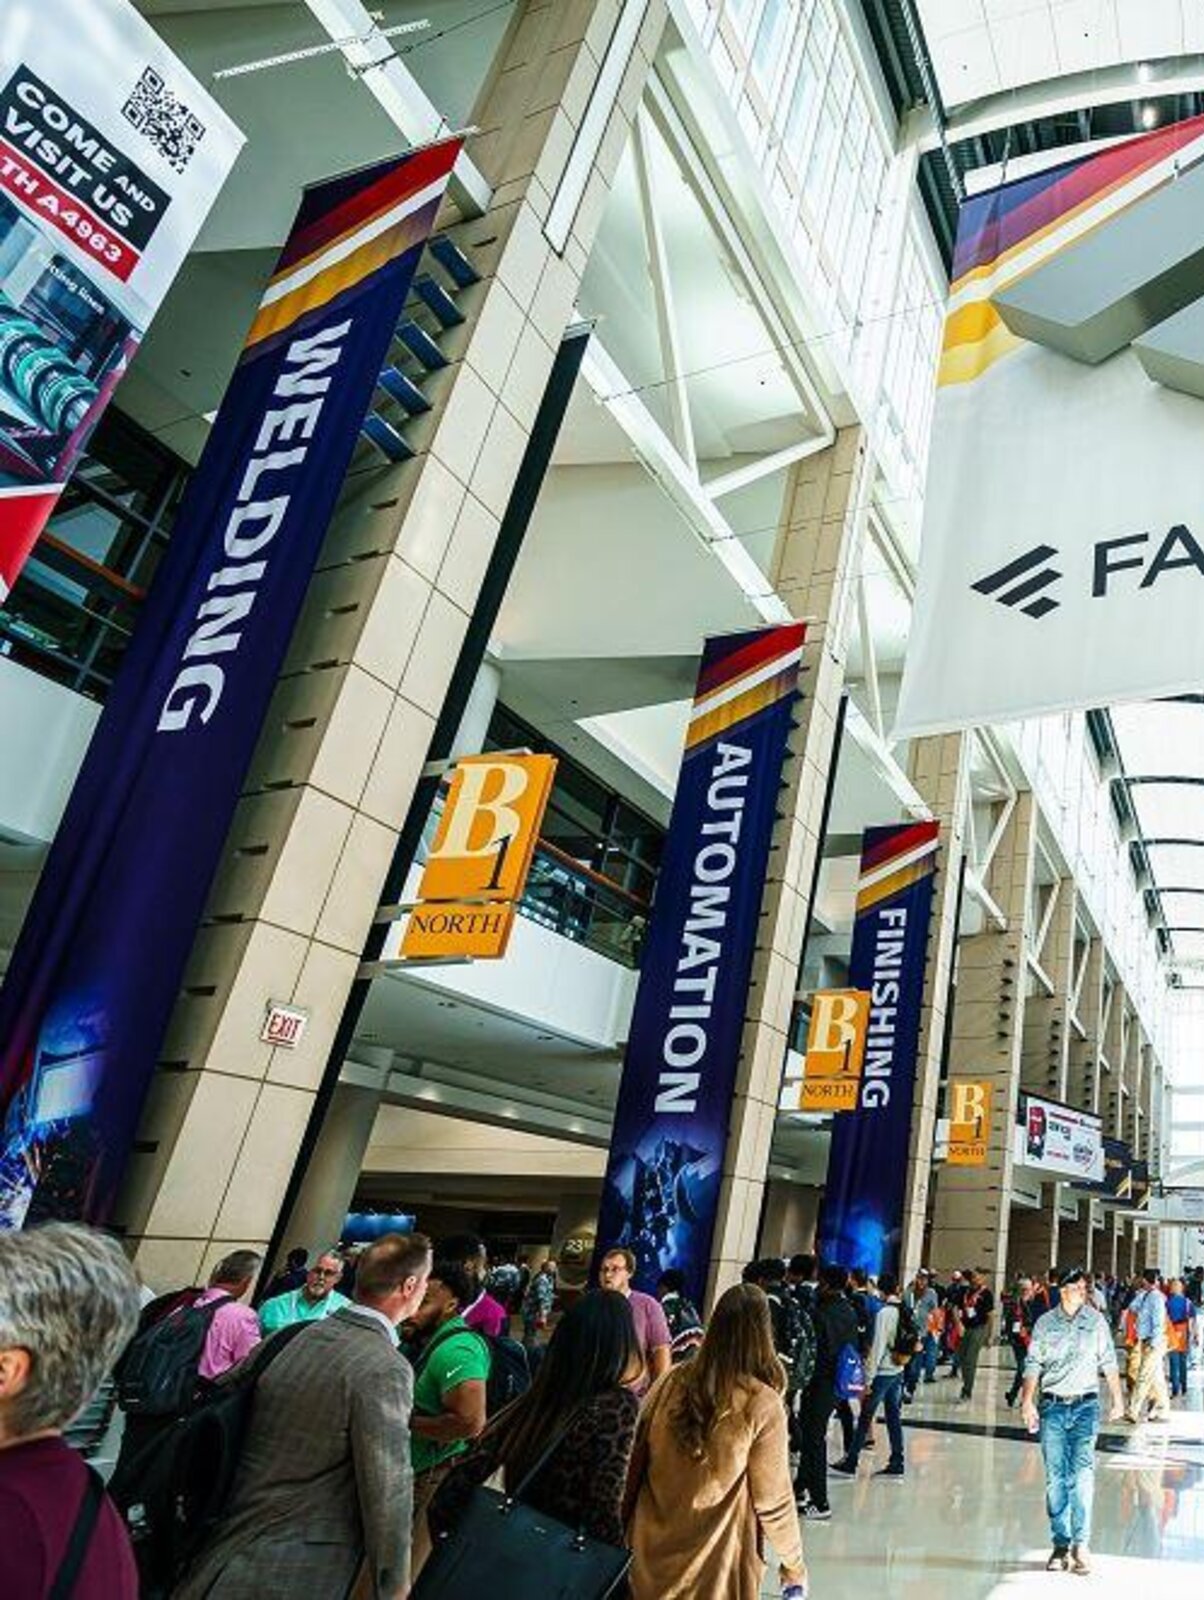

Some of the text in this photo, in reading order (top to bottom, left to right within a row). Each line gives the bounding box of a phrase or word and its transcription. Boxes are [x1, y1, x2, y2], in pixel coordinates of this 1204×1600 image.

[4, 107, 133, 228] VISIT US
[16, 81, 155, 212] COME AND
[36, 195, 122, 262] A4963
[157, 318, 353, 733] WELDING
[411, 913, 503, 934] NORTH
[654, 741, 752, 1113] AUTOMATION
[268, 1013, 302, 1039] EXIT
[861, 908, 907, 1109] FINISHING
[804, 1084, 854, 1098] NORTH
